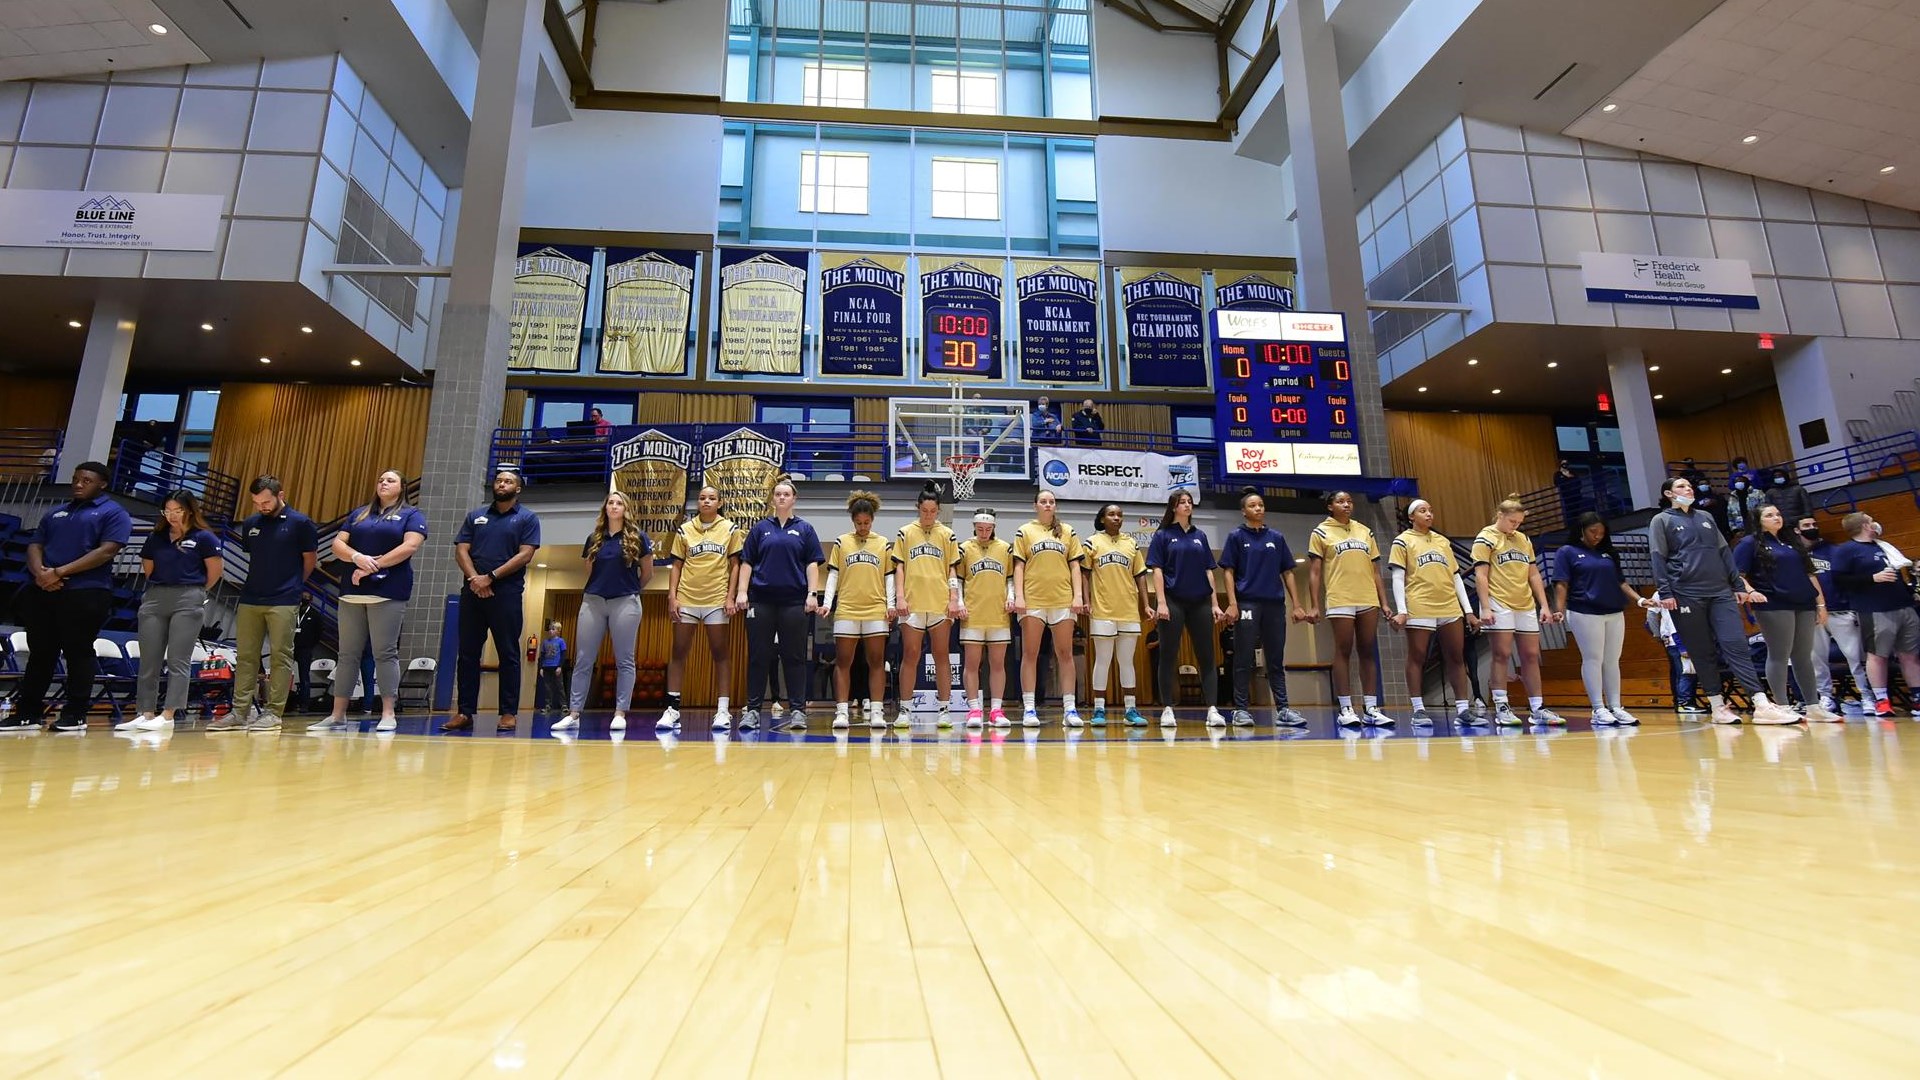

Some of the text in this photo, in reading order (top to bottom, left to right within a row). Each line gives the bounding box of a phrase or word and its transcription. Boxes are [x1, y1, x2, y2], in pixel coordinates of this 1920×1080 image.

[75, 210, 135, 221] BLUE LINE
[514, 258, 588, 286] HE MOUNT
[1651, 260, 1701, 272] Frederick
[608, 262, 693, 290] THE MOUNT
[722, 262, 806, 290] THE MOUNT
[823, 267, 903, 292] THE MOUNT
[1653, 270, 1686, 280] Health
[922, 272, 1000, 296] THE MOUNT
[1019, 275, 1095, 300] THE MOUNT
[1656, 280, 1706, 290] Medical Group
[1124, 281, 1201, 306] THE MOUNT
[1217, 284, 1293, 307] THE MOUNT
[748, 295, 777, 308] NCAA
[849, 297, 876, 310] NCAA
[512, 300, 578, 318] HAMPIONS
[1045, 306, 1072, 319] NCAA
[833, 311, 891, 324] FINAL FOUR
[1136, 313, 1192, 322] NEC TOURNAMENT
[556, 322, 578, 330] 1992
[939, 315, 988, 337] 10:00
[1027, 319, 1090, 333] TOURNAMENT
[1132, 322, 1199, 338] CHAMPIONS
[944, 340, 976, 367] 30
[1222, 344, 1245, 355] Home
[1263, 343, 1312, 364] 10:00
[1318, 347, 1346, 358] Guests
[1236, 357, 1251, 378] 0
[1335, 360, 1349, 381] 0
[1272, 377, 1299, 387] period
[1309, 375, 1315, 389] 1
[1228, 393, 1248, 403] fouls
[1275, 394, 1301, 404] player
[1327, 395, 1347, 405] fouls
[1236, 407, 1247, 423] 0
[1271, 407, 1307, 425] 0-00
[1334, 409, 1346, 425] 0
[1230, 427, 1253, 437] match
[1280, 429, 1301, 438] game
[1329, 429, 1352, 439] match
[614, 440, 688, 466] THE MOUNT
[705, 439, 782, 466] THE MOUNT
[1241, 448, 1265, 460] Roy
[1078, 464, 1143, 478] RESPECT.
[1236, 458, 1278, 473] Rogers
[1813, 464, 1819, 473] 9
[719, 476, 765, 486] NORTHEAST
[1045, 471, 1071, 480] NCAA
[1167, 472, 1193, 486] NEC
[626, 478, 672, 488] NORTHEAST
[1099, 479, 1120, 487] name
[1128, 480, 1139, 488] the
[1139, 481, 1160, 489] game.
[627, 491, 673, 501] ONFERENCE
[720, 488, 768, 499] ONFERENCE
[650, 504, 682, 515] SEASON
[690, 543, 725, 556] THE MOUNT
[910, 546, 944, 559] THE MOUNT
[1031, 541, 1045, 554] THE
[1336, 541, 1350, 555] THE
[846, 552, 880, 569] THE MOUNT
[1099, 553, 1112, 566] THE
[1418, 554, 1431, 567] THE
[1498, 552, 1511, 564] THE
[970, 560, 1004, 575] THE MOUNT
[1240, 609, 1254, 620] M
[1680, 606, 1692, 614] M
[925, 664, 962, 674] PRCT
